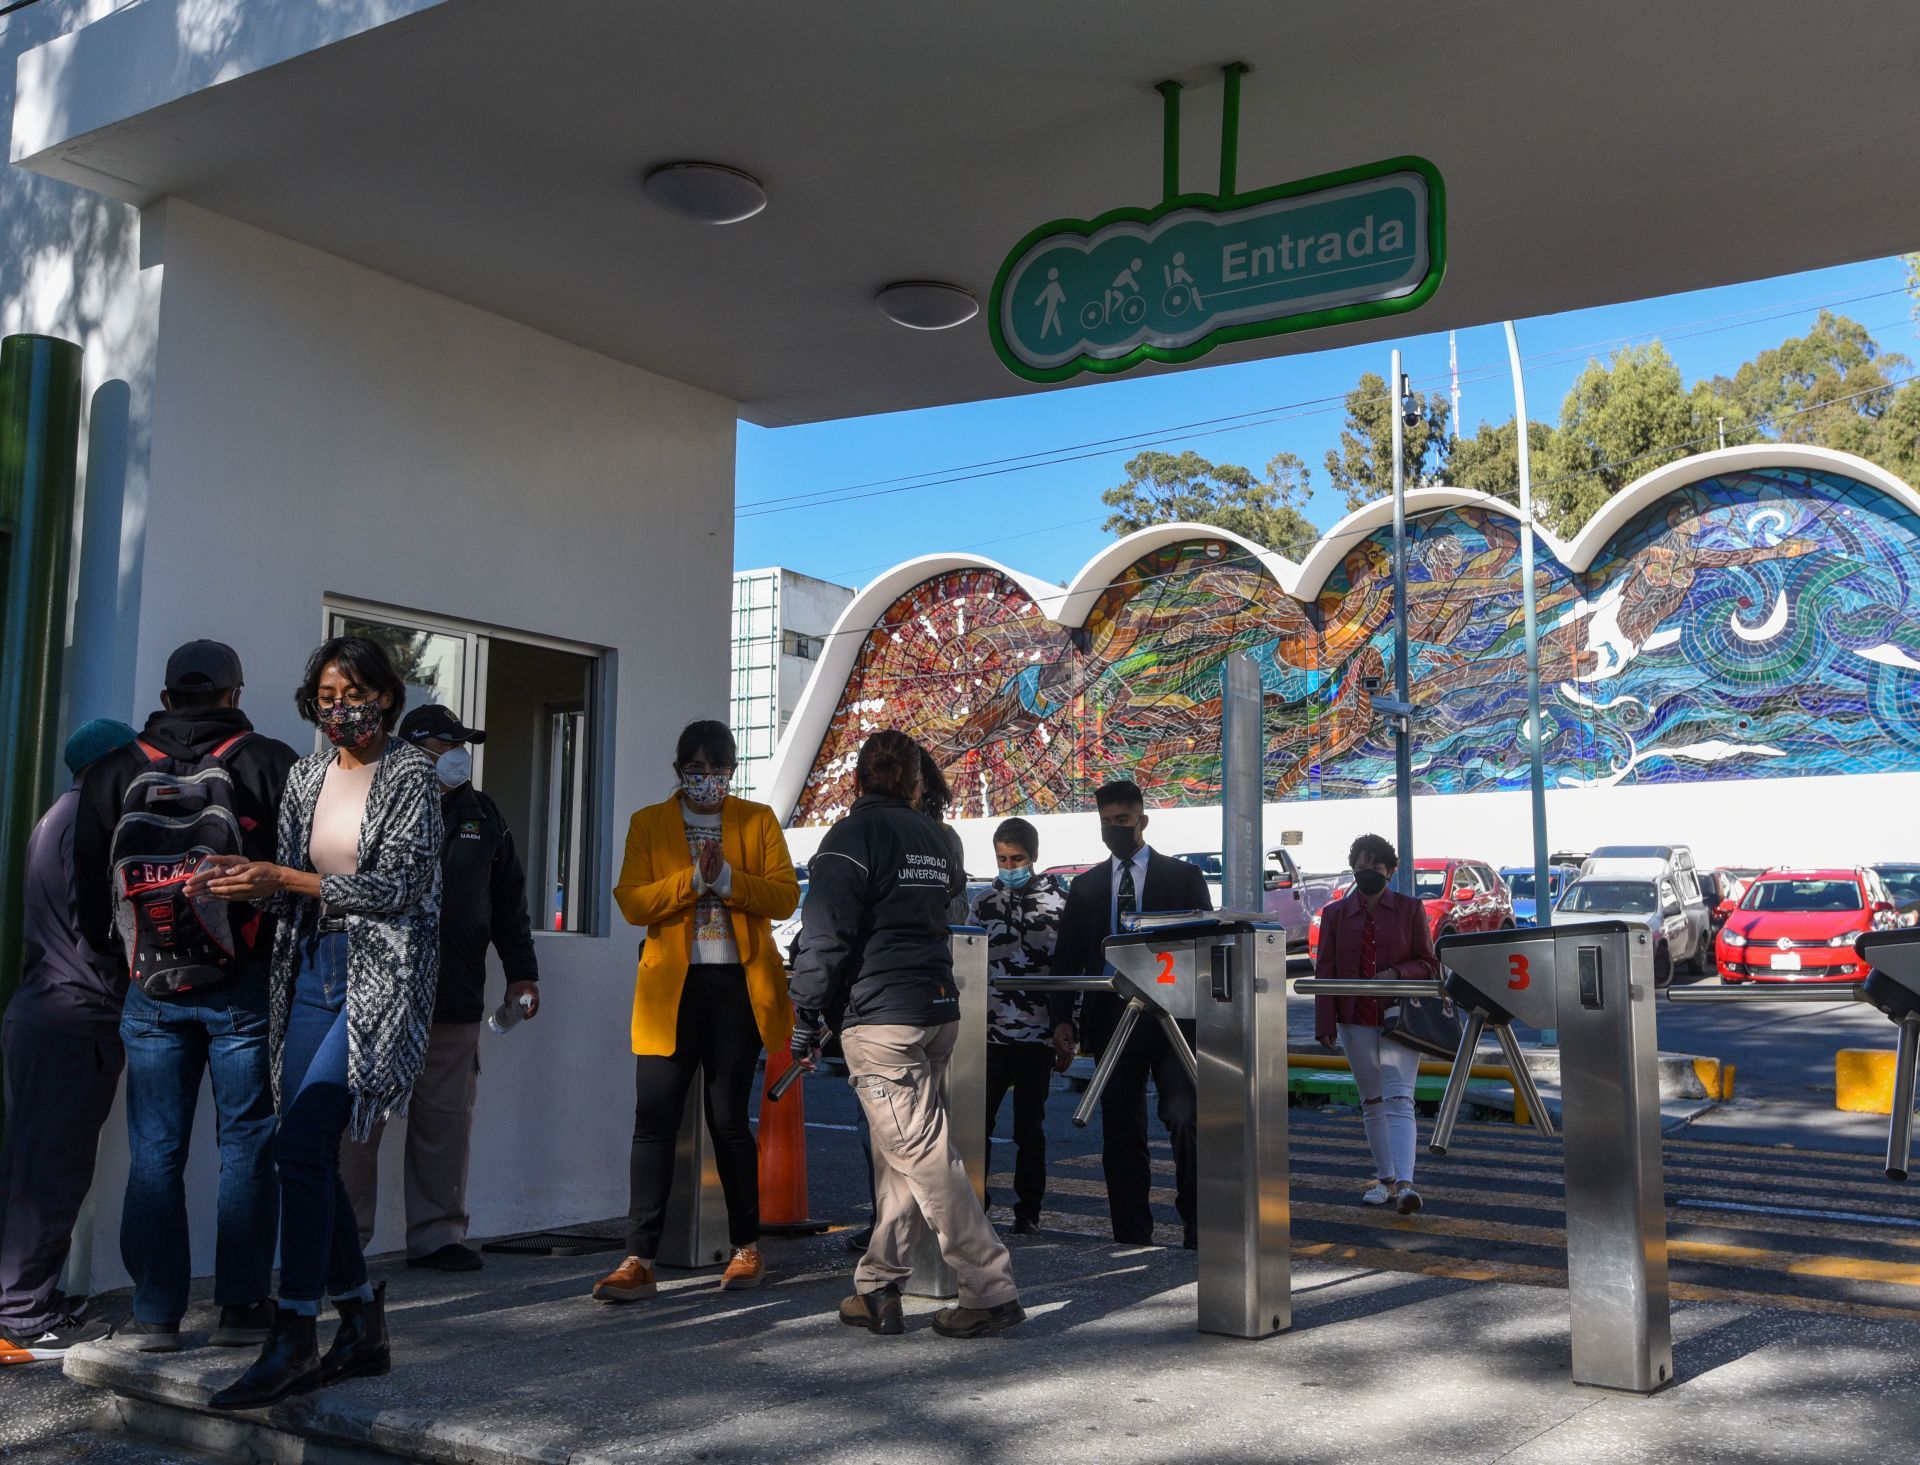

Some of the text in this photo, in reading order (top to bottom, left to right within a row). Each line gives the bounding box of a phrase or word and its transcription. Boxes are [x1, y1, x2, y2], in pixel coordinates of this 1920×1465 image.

[1222, 214, 1404, 283] Entrada
[898, 868, 950, 884] UNIVERSITARIA
[906, 854, 947, 868] SEGURIDAD
[1156, 951, 1176, 985] 2
[1507, 953, 1530, 991] 3
